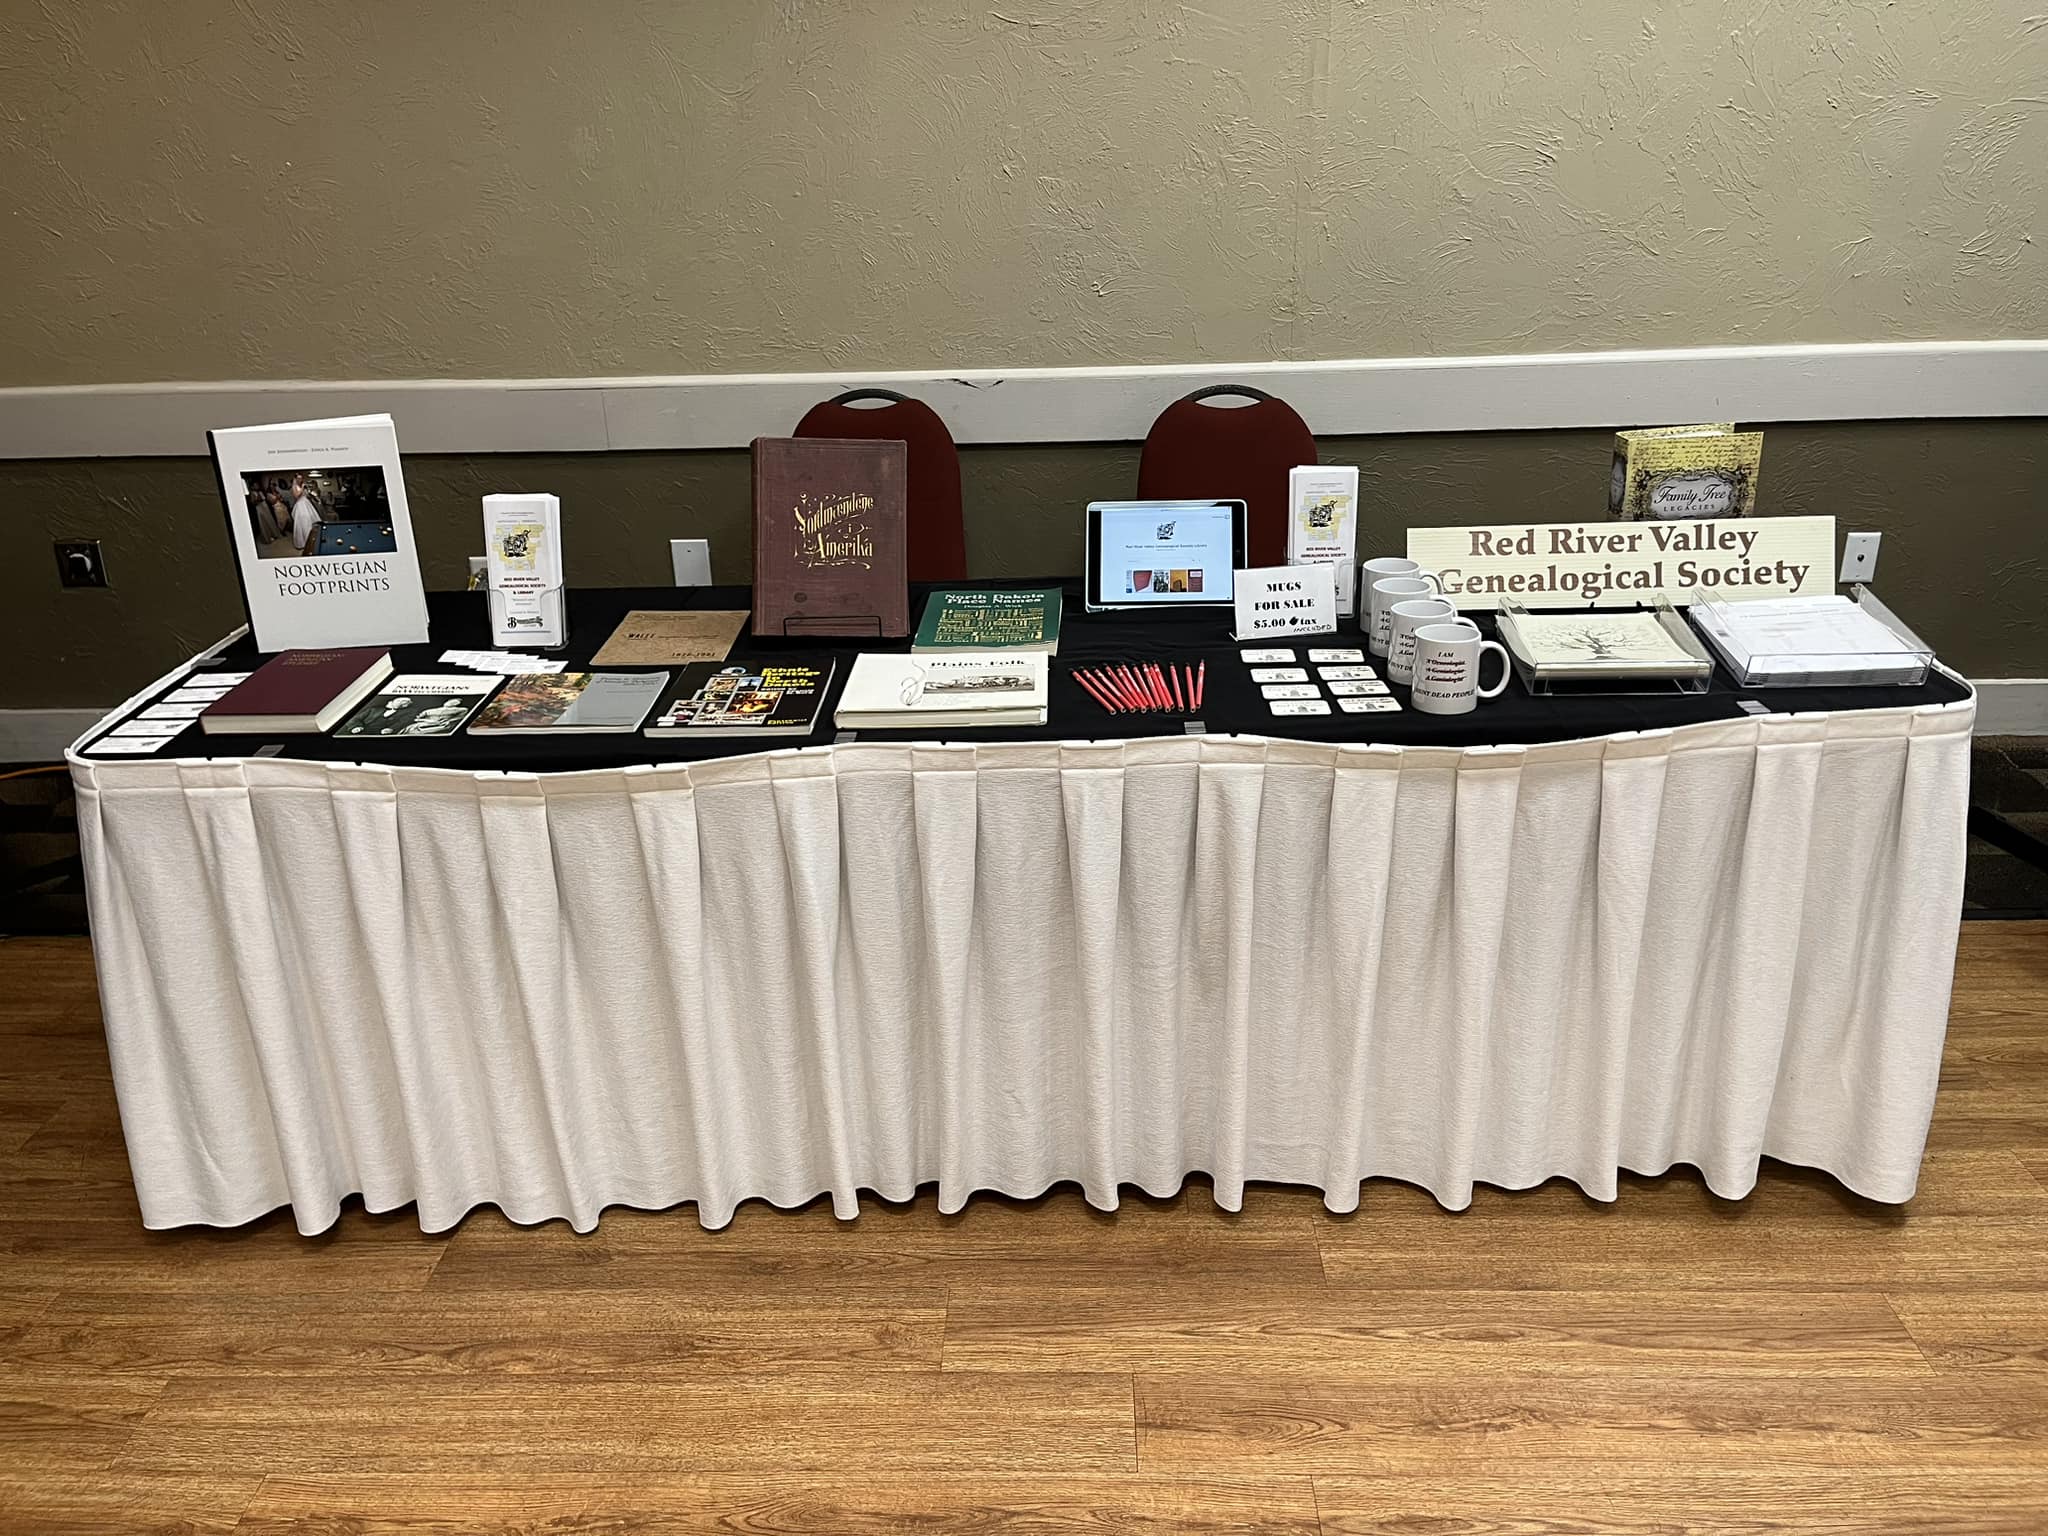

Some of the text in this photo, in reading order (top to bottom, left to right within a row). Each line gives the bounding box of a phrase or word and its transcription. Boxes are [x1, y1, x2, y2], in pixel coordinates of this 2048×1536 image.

[1654, 483, 1726, 505] Family Tree
[1663, 503, 1715, 512] LEGACIES
[810, 533, 873, 559] Amerika
[1468, 523, 1759, 558] Red River Valley
[273, 560, 387, 580] NORWEGIAN
[1440, 559, 1811, 599] Genealogical Society
[278, 577, 391, 597] FOOTPRINTS
[1266, 581, 1301, 592] MUGS
[1254, 599, 1315, 611] FOR SALE
[1253, 618, 1286, 629] $5.00
[1300, 617, 1317, 625] tax
[1452, 689, 1475, 698] PEOPLE
